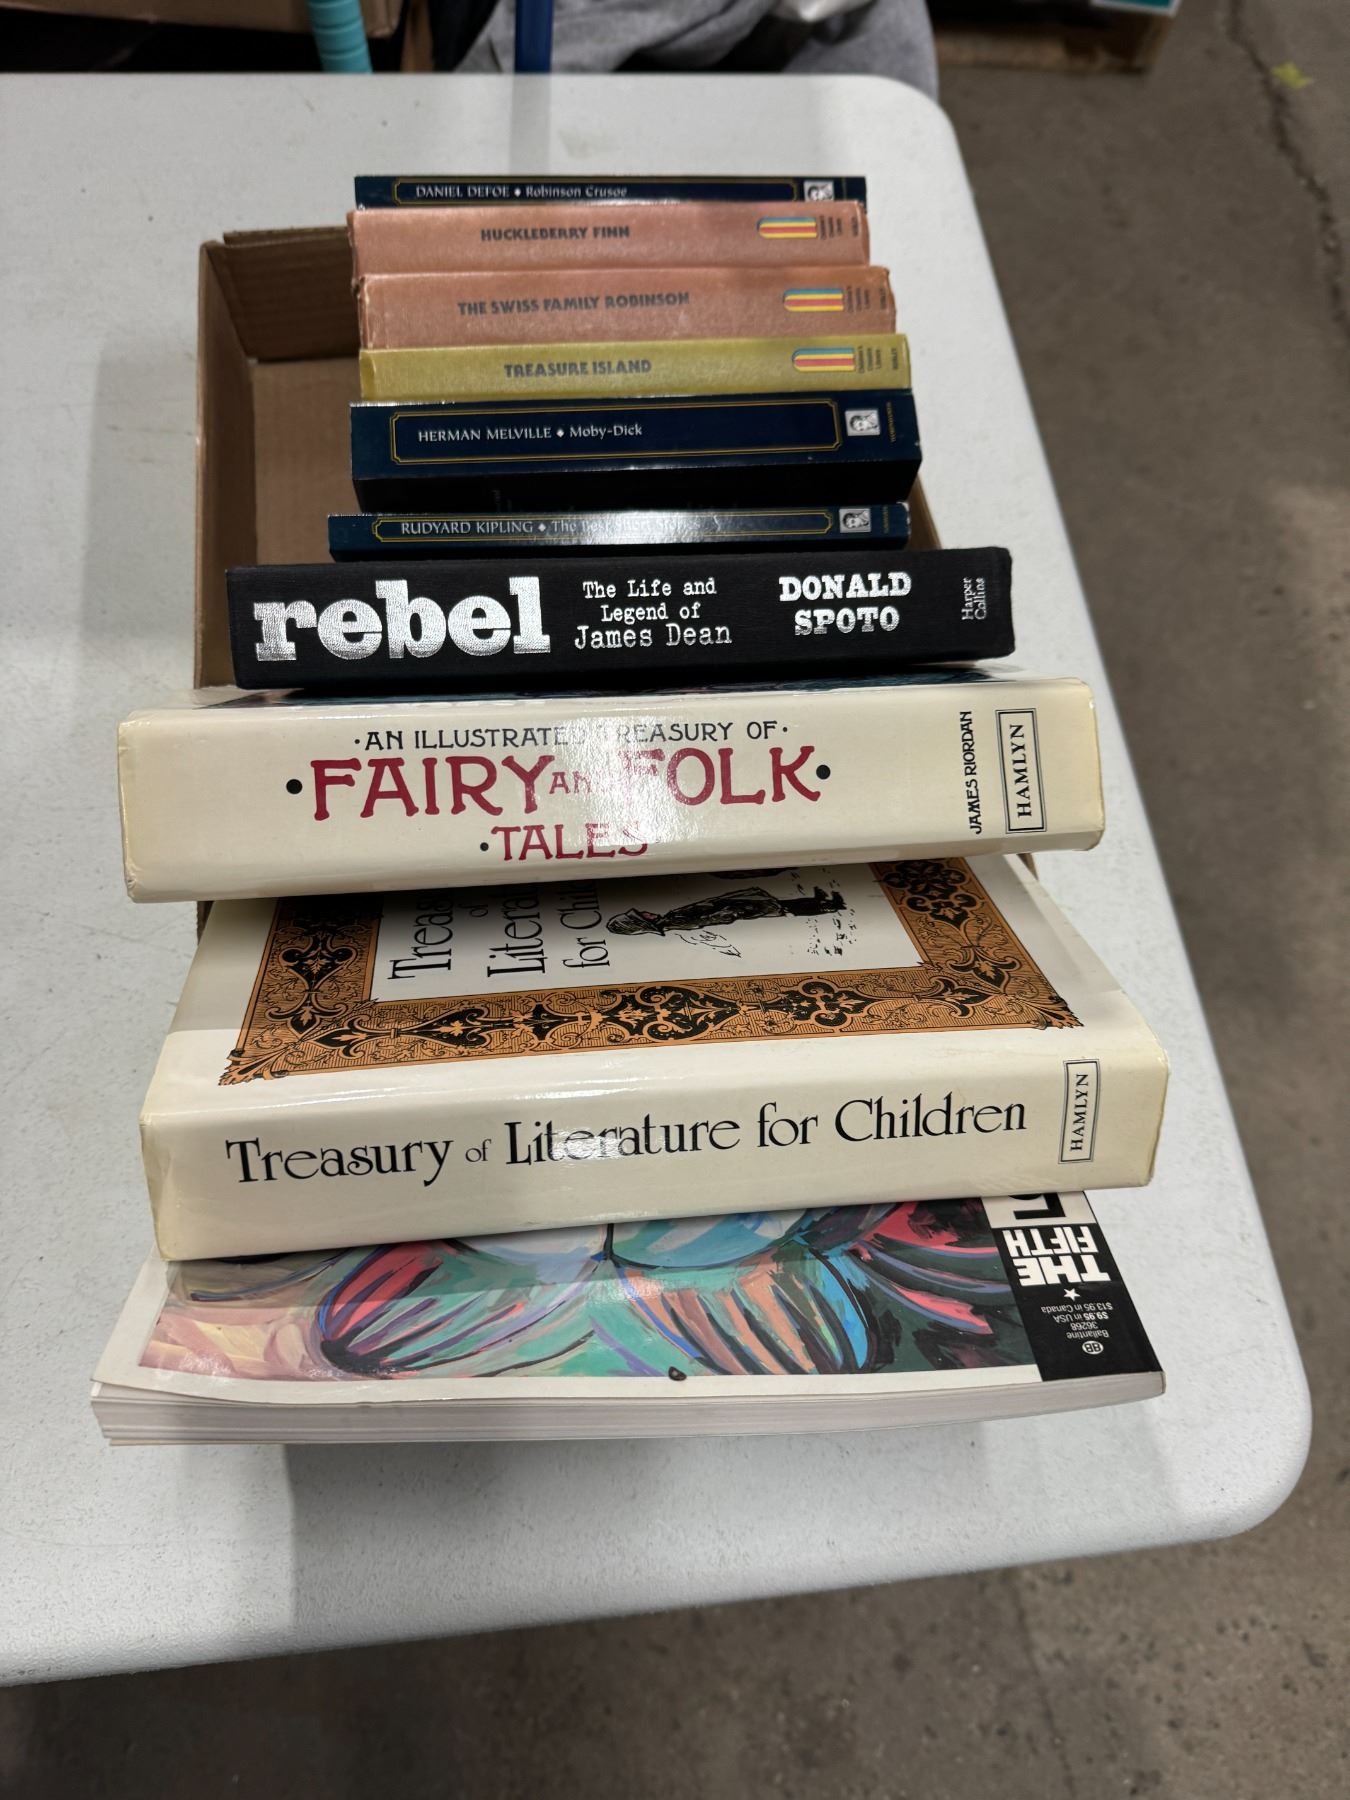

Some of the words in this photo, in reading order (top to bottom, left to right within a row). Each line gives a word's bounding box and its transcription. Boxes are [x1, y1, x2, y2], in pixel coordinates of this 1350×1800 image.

[415, 184, 463, 197] DANIEL
[467, 184, 510, 197] DEFOE
[525, 184, 581, 197] Robinson
[585, 184, 627, 197] Crusoe
[480, 226, 588, 242] HUCKLEBERRY
[593, 224, 631, 240] FINN
[458, 300, 487, 315] THE
[492, 298, 540, 314] SWISS
[543, 295, 600, 312] FAMILY
[604, 291, 690, 309] ROBINSON
[504, 362, 589, 378] TREASURE
[592, 359, 652, 375] ISLAND
[418, 427, 482, 443] HERMAN
[486, 425, 553, 441] MELVILLE
[569, 422, 643, 440] Moby-Dick
[401, 519, 472, 535] RUDYARD
[476, 519, 534, 534] KIPLING
[552, 520, 577, 533] The
[583, 580, 618, 600] The
[627, 578, 672, 598] Life
[683, 577, 718, 597] and
[779, 571, 912, 603] DONALD
[961, 577, 975, 621] Harper
[973, 577, 987, 620] Collins
[253, 576, 552, 663] rebel
[600, 601, 668, 623] Legend
[679, 599, 702, 620] of
[794, 605, 901, 637] SPOTO
[573, 624, 656, 650] James
[666, 623, 732, 647] Dean
[364, 729, 404, 751] AN
[746, 720, 777, 739] OF
[959, 710, 977, 776] RIORDAN
[311, 754, 555, 821] FAIRY
[619, 745, 822, 811] FOLK
[1009, 724, 1032, 818] HAMLYN
[965, 778, 983, 835] JAMES
[491, 822, 648, 862] TALES
[562, 936, 610, 969] for
[1069, 1072, 1090, 1153] HAMLYN
[226, 1136, 454, 1190] Treasury
[464, 1138, 492, 1165] of
[504, 1112, 741, 1168] Literature
[758, 1101, 819, 1153] for
[834, 1093, 1026, 1145] Children
[1002, 1226, 1099, 1257] FIFTH
[1012, 1254, 1111, 1286] THE
[1040, 1304, 1074, 1315] Canada
[1053, 1313, 1074, 1323] USA
[1074, 1303, 1082, 1313] in
[1074, 1313, 1082, 1321] in
[1083, 1301, 1114, 1312] $13.95
[1083, 1310, 1109, 1321] $9.95
[1065, 1328, 1110, 1340] Ballantine
[1070, 1321, 1098, 1331] 36268
